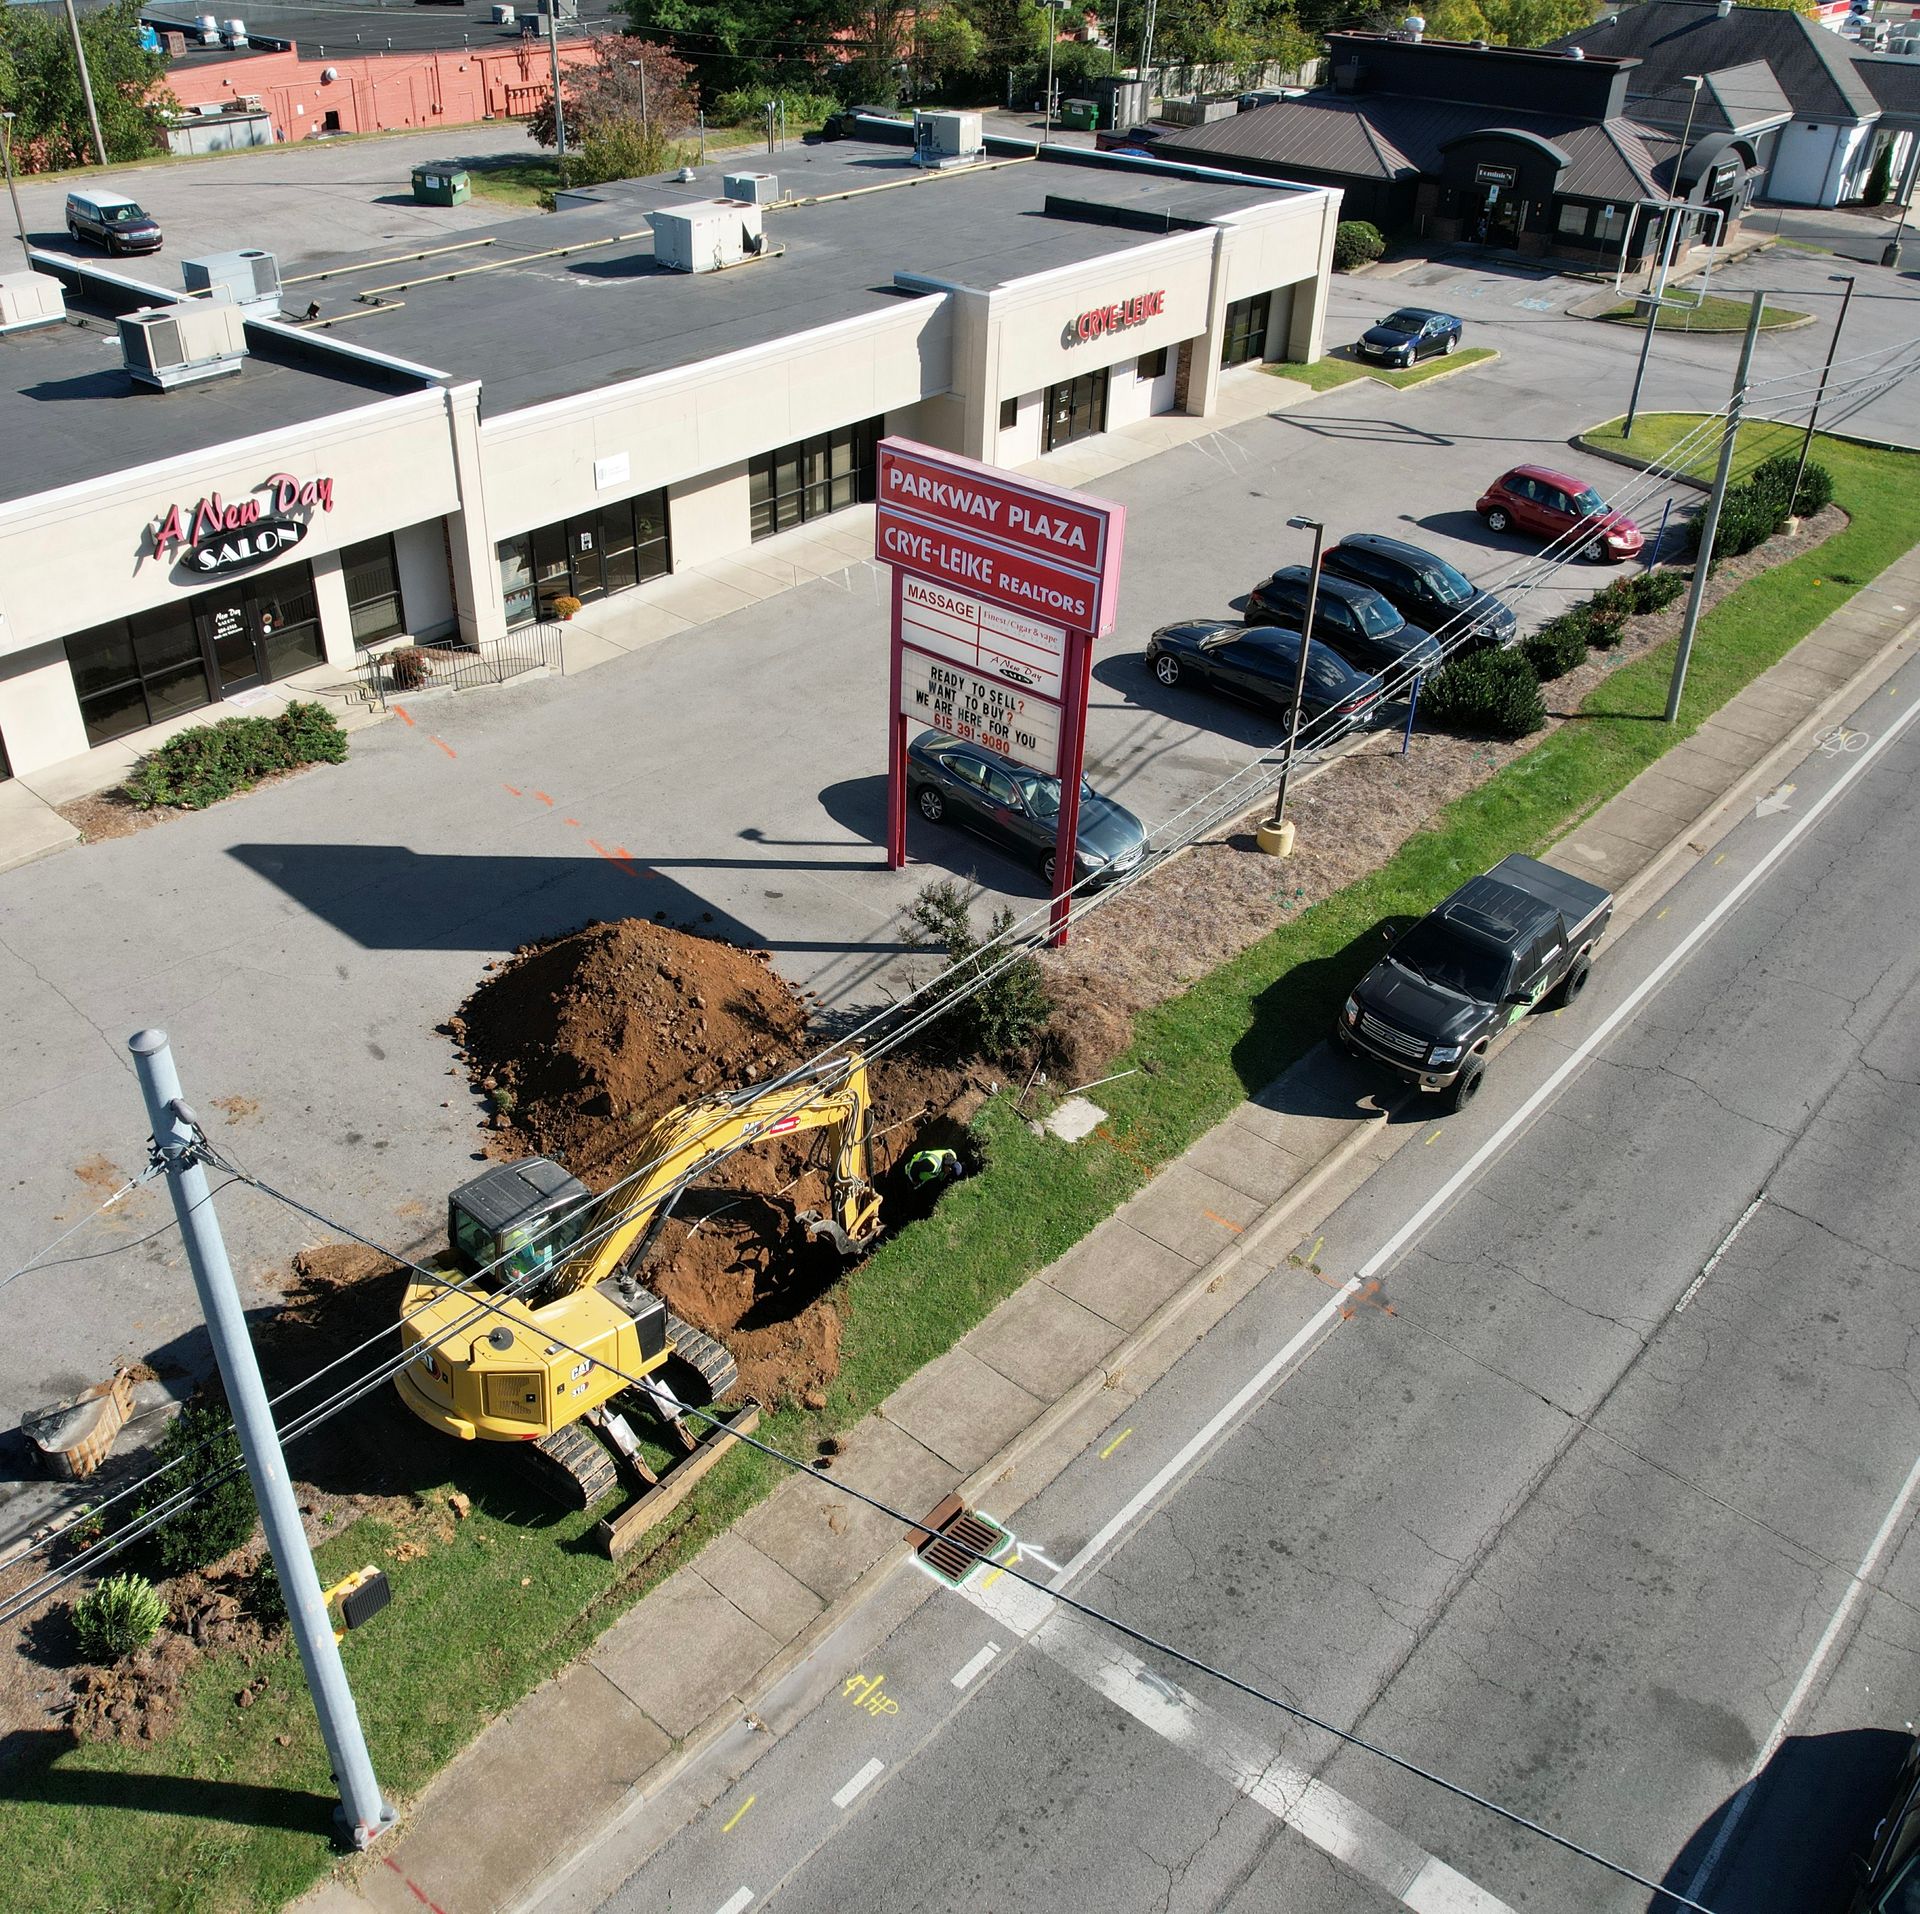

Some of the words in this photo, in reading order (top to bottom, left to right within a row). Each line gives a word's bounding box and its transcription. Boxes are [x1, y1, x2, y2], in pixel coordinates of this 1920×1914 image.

[1078, 290, 1166, 340] CRYE-LEIKE
[153, 504, 184, 560] A
[190, 491, 260, 548] New
[267, 472, 334, 513] Day
[890, 469, 1001, 522] PARKWAY
[1008, 505, 1086, 551] PLAZA
[198, 523, 299, 571] SALON
[884, 527, 994, 584] CRYE-LEIKE
[999, 574, 1085, 616] REALTORS
[908, 584, 975, 619] MASSAGE
[931, 666, 965, 690] READY
[972, 682, 985, 698] TO
[990, 689, 1025, 714] SELL?
[990, 656, 999, 664] A
[1000, 659, 1020, 672] New
[1023, 666, 1042, 682] Day
[916, 689, 929, 706] WE
[934, 698, 953, 716] ARE
[958, 707, 982, 728] HERE
[989, 721, 1009, 739] FOR
[1015, 730, 1036, 749] YOU
[928, 680, 957, 702] WANT
[965, 695, 978, 710] TO
[983, 703, 1014, 727] BUY?
[934, 714, 952, 730] 615
[957, 722, 1010, 754] 391-9080
[571, 1359, 591, 1381] CAT
